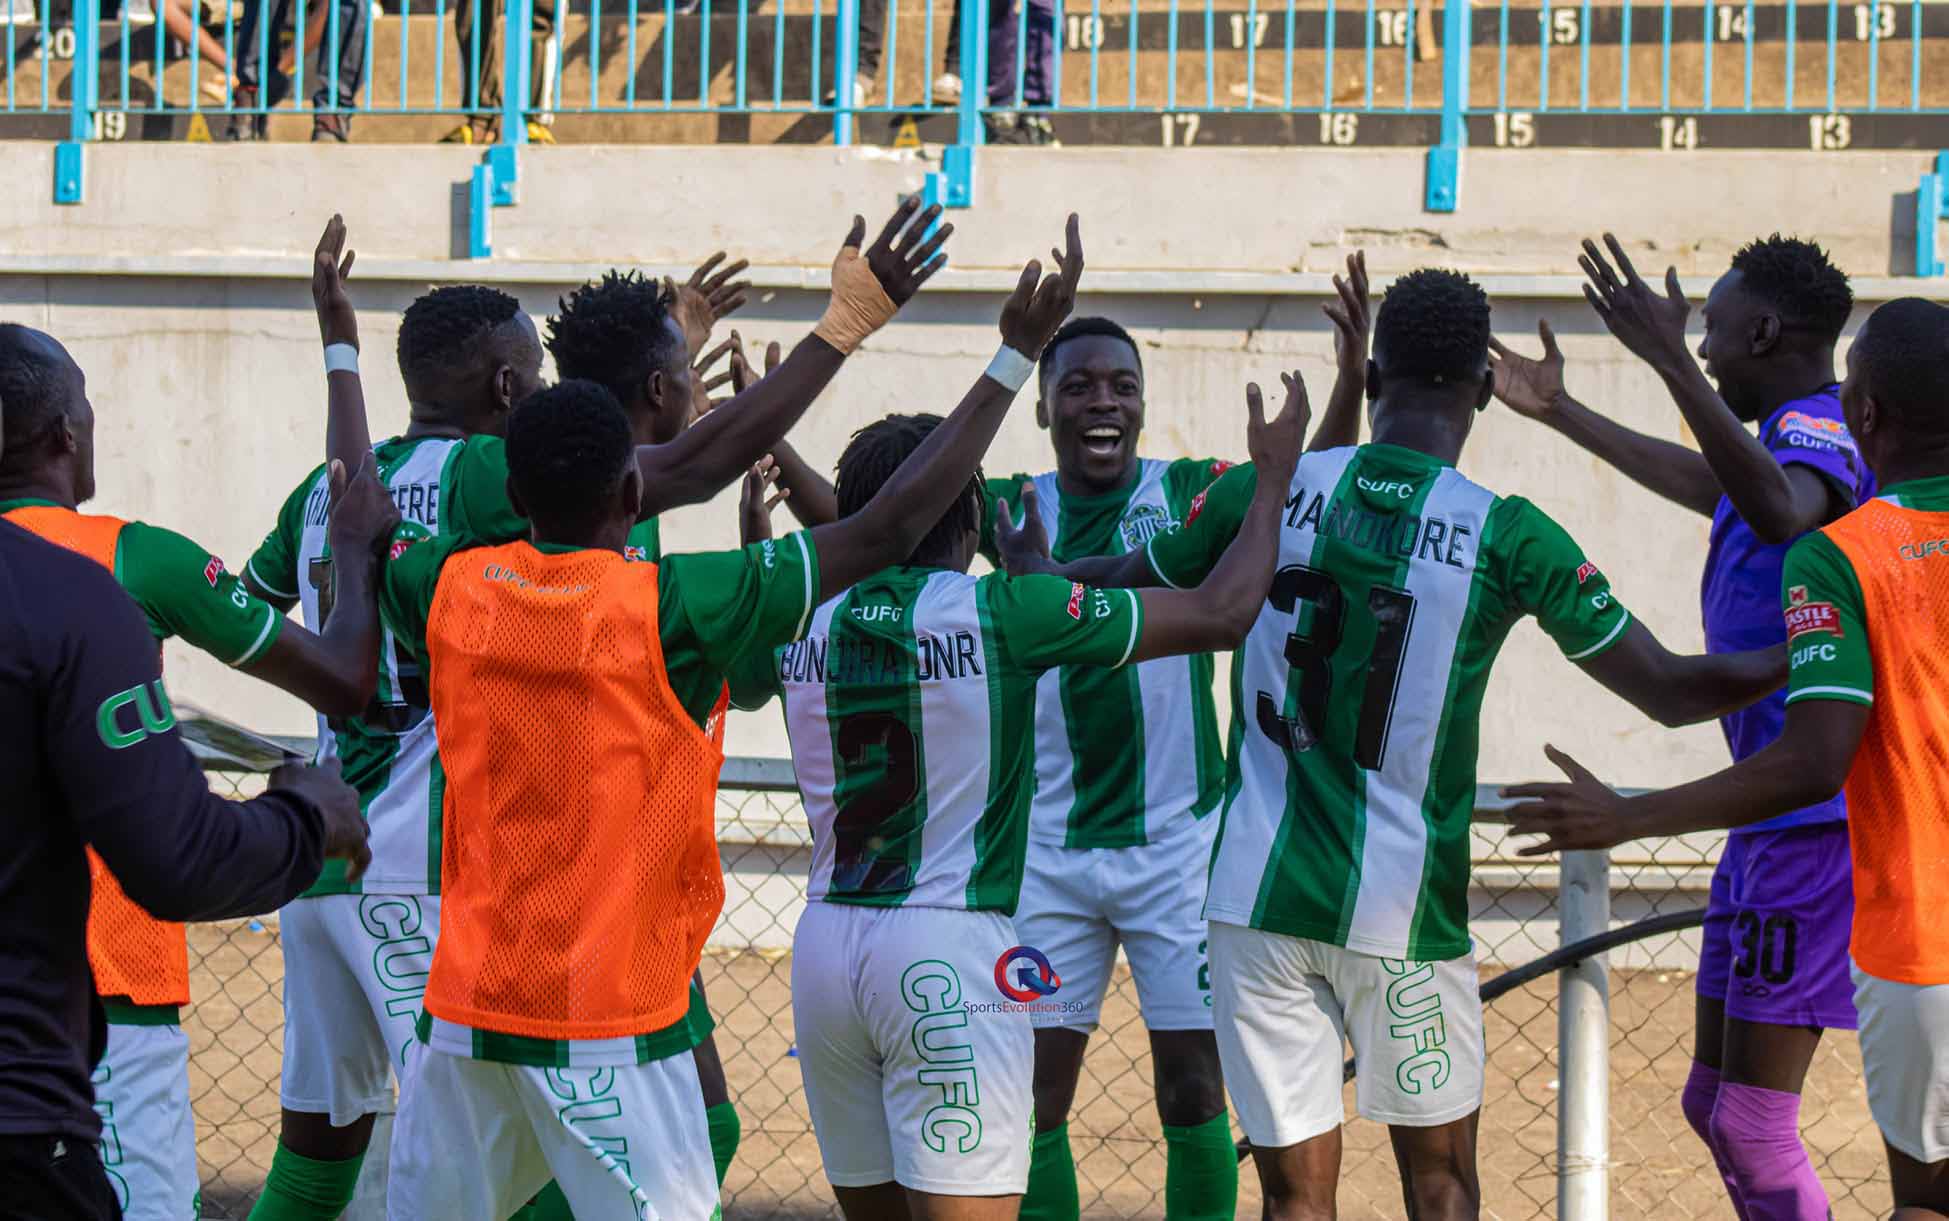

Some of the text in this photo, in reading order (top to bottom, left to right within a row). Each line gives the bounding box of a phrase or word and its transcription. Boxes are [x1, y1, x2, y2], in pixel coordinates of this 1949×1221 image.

[1230, 13, 1269, 49] 17
[1718, 5, 1755, 41] 14
[1855, 4, 1896, 41] 13
[34, 27, 77, 60] 20
[92, 111, 127, 141] 19
[1161, 113, 1201, 147] 17
[1319, 112, 1359, 145] 16
[1493, 111, 1535, 147] 15
[1657, 116, 1698, 150] 14
[1809, 114, 1851, 150] 13
[1356, 476, 1414, 499] CUFC
[1256, 563, 1418, 772] 31
[831, 711, 922, 890] 2
[1733, 910, 1797, 984] 30
[900, 959, 982, 1154] CUFC
